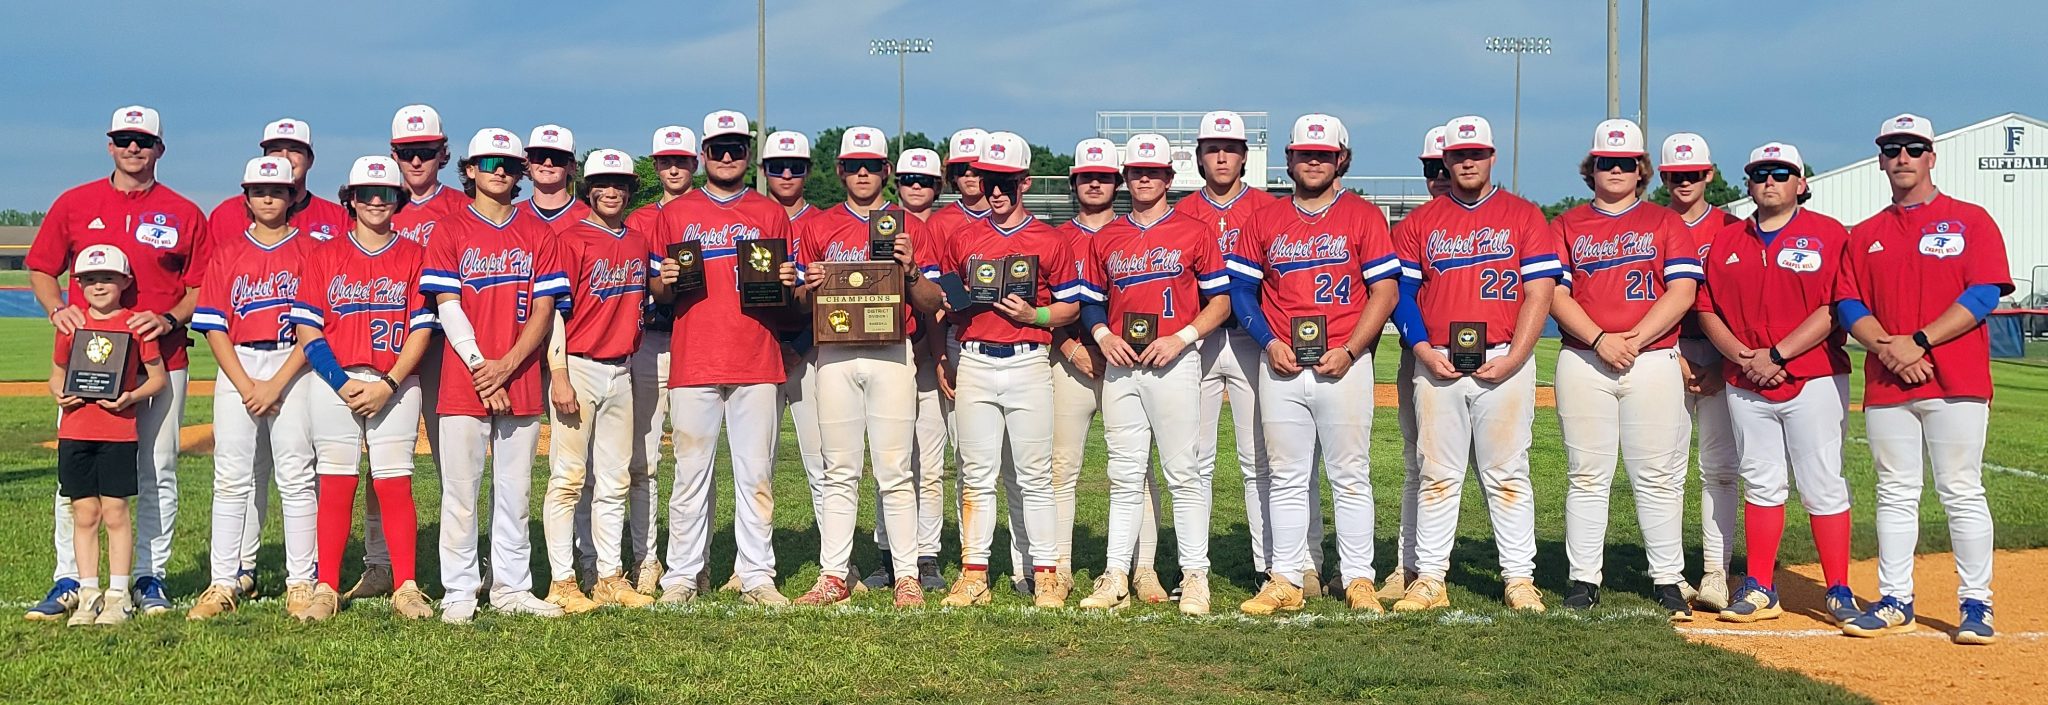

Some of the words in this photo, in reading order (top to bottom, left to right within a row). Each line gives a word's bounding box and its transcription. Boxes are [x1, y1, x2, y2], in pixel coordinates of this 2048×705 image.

[2003, 126, 2025, 155] F
[1980, 158, 2048, 169] SOFTBALL
[1268, 234, 1313, 263] Chapel
[1315, 233, 1348, 259] Hill
[1426, 229, 1476, 261] Chapel
[1476, 227, 1511, 254] Hill
[1572, 234, 1620, 263] Chapel
[1620, 231, 1654, 256] Hill
[460, 248, 508, 279] Chapel
[590, 258, 629, 289] Chapel
[1107, 250, 1149, 279] Chapel
[1150, 247, 1183, 274] Hill
[231, 272, 274, 307] Chapel
[328, 274, 373, 305] Chapel
[374, 277, 407, 304] Hill
[826, 295, 890, 303] CHAMPIONS
[1314, 272, 1351, 305] 24
[1480, 268, 1519, 301] 22
[1625, 269, 1657, 301] 21
[1162, 287, 1175, 318] 1
[370, 318, 404, 354] 20
